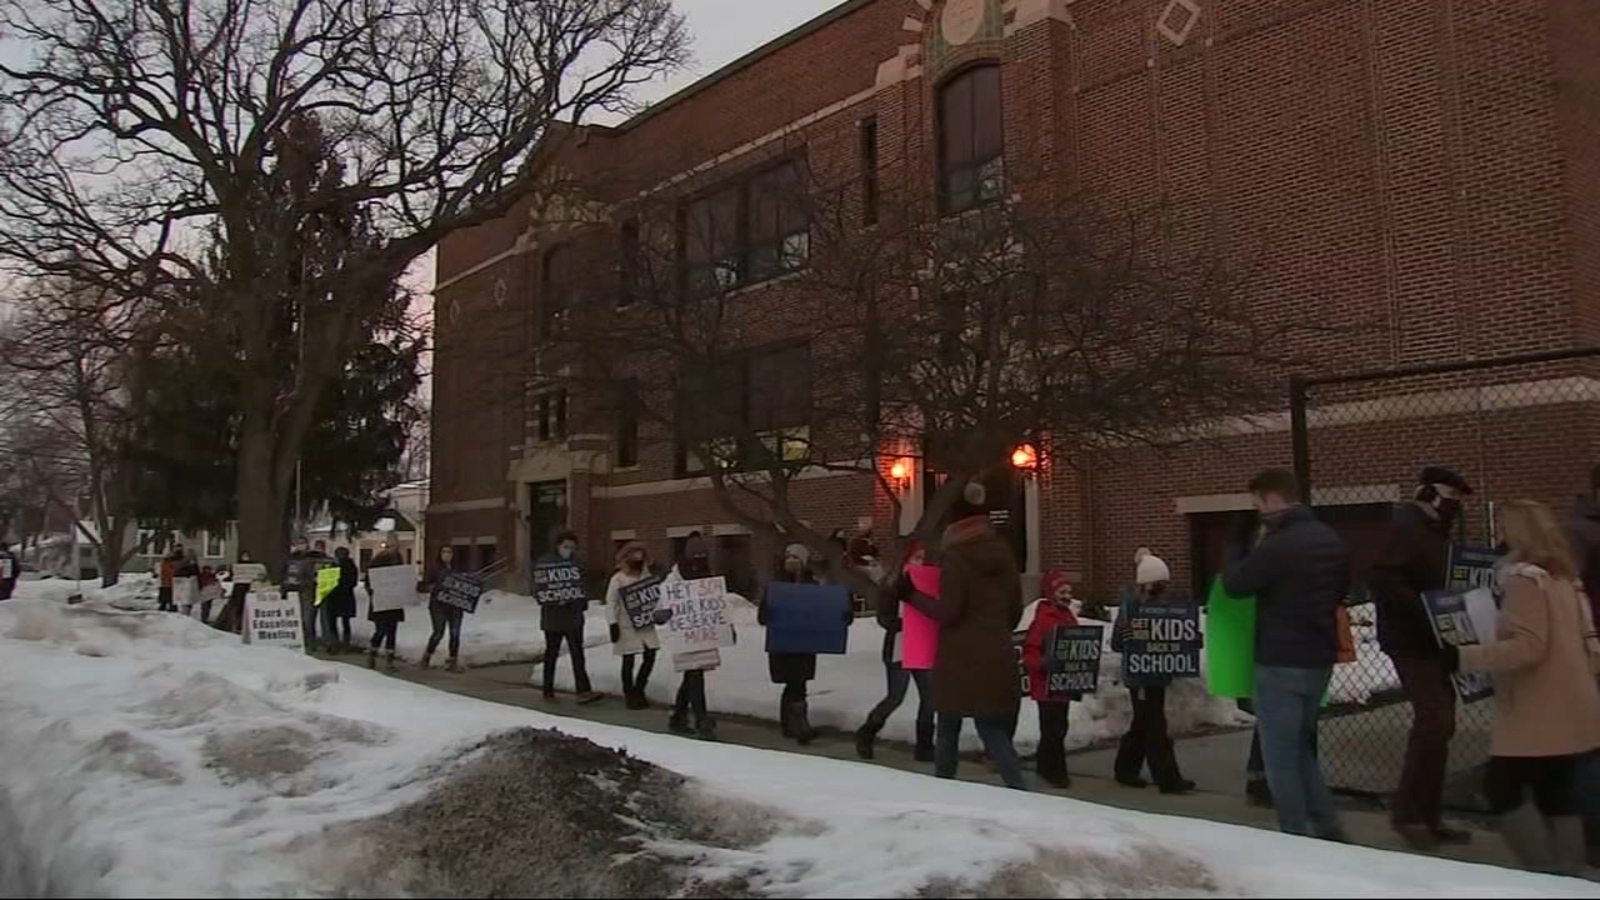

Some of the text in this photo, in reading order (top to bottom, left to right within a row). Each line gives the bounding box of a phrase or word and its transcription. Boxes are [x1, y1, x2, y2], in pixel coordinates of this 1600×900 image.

[547, 567, 581, 581] KIDS
[1470, 567, 1494, 588] KID
[537, 588, 585, 602] SCHOOL
[638, 584, 660, 603] KID
[665, 581, 691, 599] HEY
[254, 607, 295, 618] Board of
[670, 600, 696, 616] OUR
[253, 619, 299, 629] Education
[669, 611, 726, 631] DESERVE
[1151, 618, 1196, 641] KIDS
[258, 631, 296, 640] Meeting
[1069, 640, 1100, 660] KIDS
[1129, 654, 1197, 673] SCHOOL
[1050, 672, 1095, 691] SCHOOL
